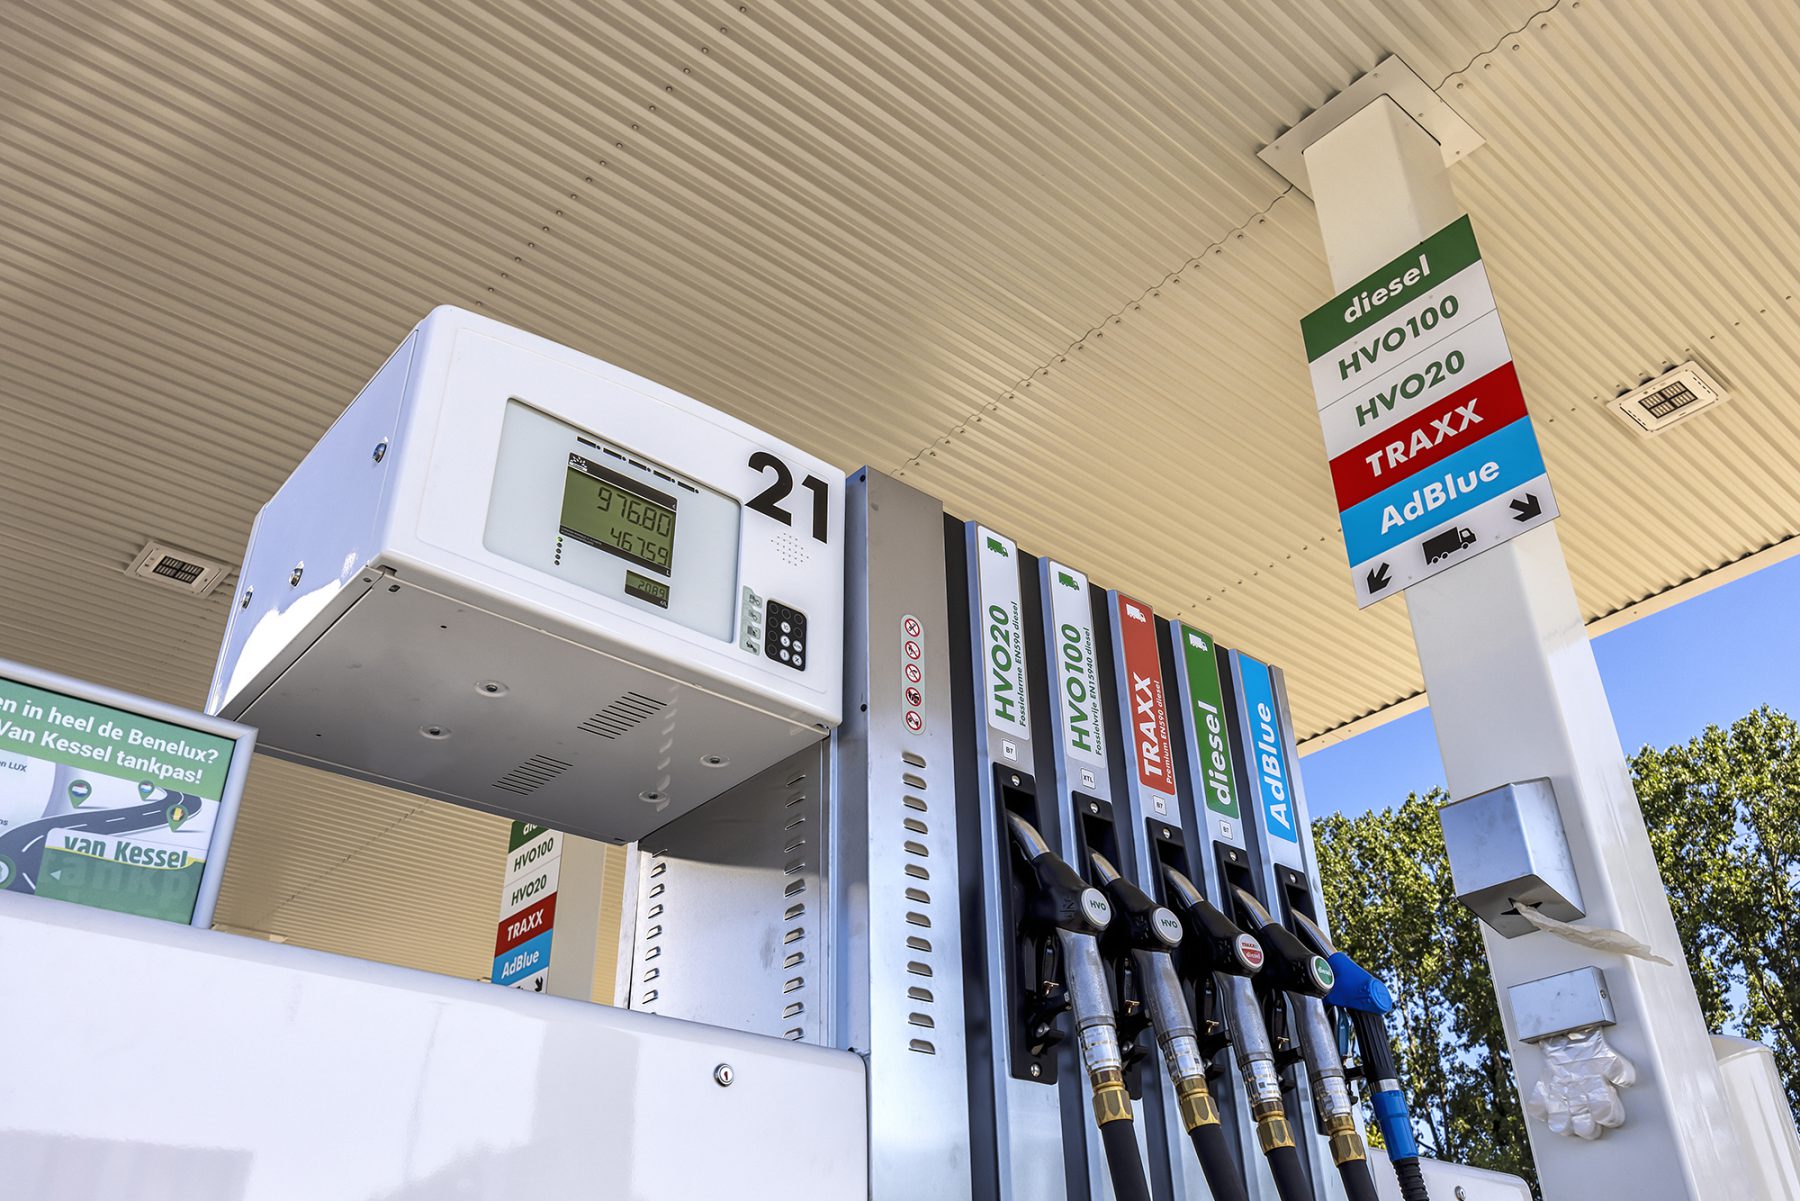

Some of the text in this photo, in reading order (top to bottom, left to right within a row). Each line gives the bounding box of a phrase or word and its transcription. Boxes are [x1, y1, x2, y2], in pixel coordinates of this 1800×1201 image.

[1344, 254, 1430, 323] diesel
[1338, 295, 1459, 380] HVO100
[1355, 350, 1465, 427] HVO20
[1365, 398, 1484, 477] TRAXX
[744, 451, 829, 545] 21
[1381, 461, 1499, 535] AdBlue
[988, 604, 1016, 723] HVO20
[1010, 600, 1026, 727] Fossielarme EN590 diesel
[1061, 623, 1091, 752] HVO100
[1082, 627, 1102, 756] Fossielvrije EN15940 diesel
[1154, 680, 1162, 708] diesel
[22, 700, 43, 720] in
[48, 706, 95, 733] heel
[98, 721, 124, 741] de
[128, 728, 219, 764] Benelux?
[40, 731, 113, 762] Kessel
[116, 750, 203, 784] tankpas!
[1133, 671, 1162, 776] TRAXX
[1159, 710, 1168, 740] EN590
[1198, 700, 1231, 805] diesel
[8, 761, 28, 773] LUX
[1257, 702, 1290, 830] AdBlue
[64, 836, 188, 868] van Kessel
[514, 837, 554, 872] HVO100
[507, 908, 544, 941] TRAXX
[511, 874, 547, 906] HVO20
[1090, 900, 1107, 911] HVO
[1160, 919, 1178, 929] HVO
[501, 950, 540, 979] AdBlue
